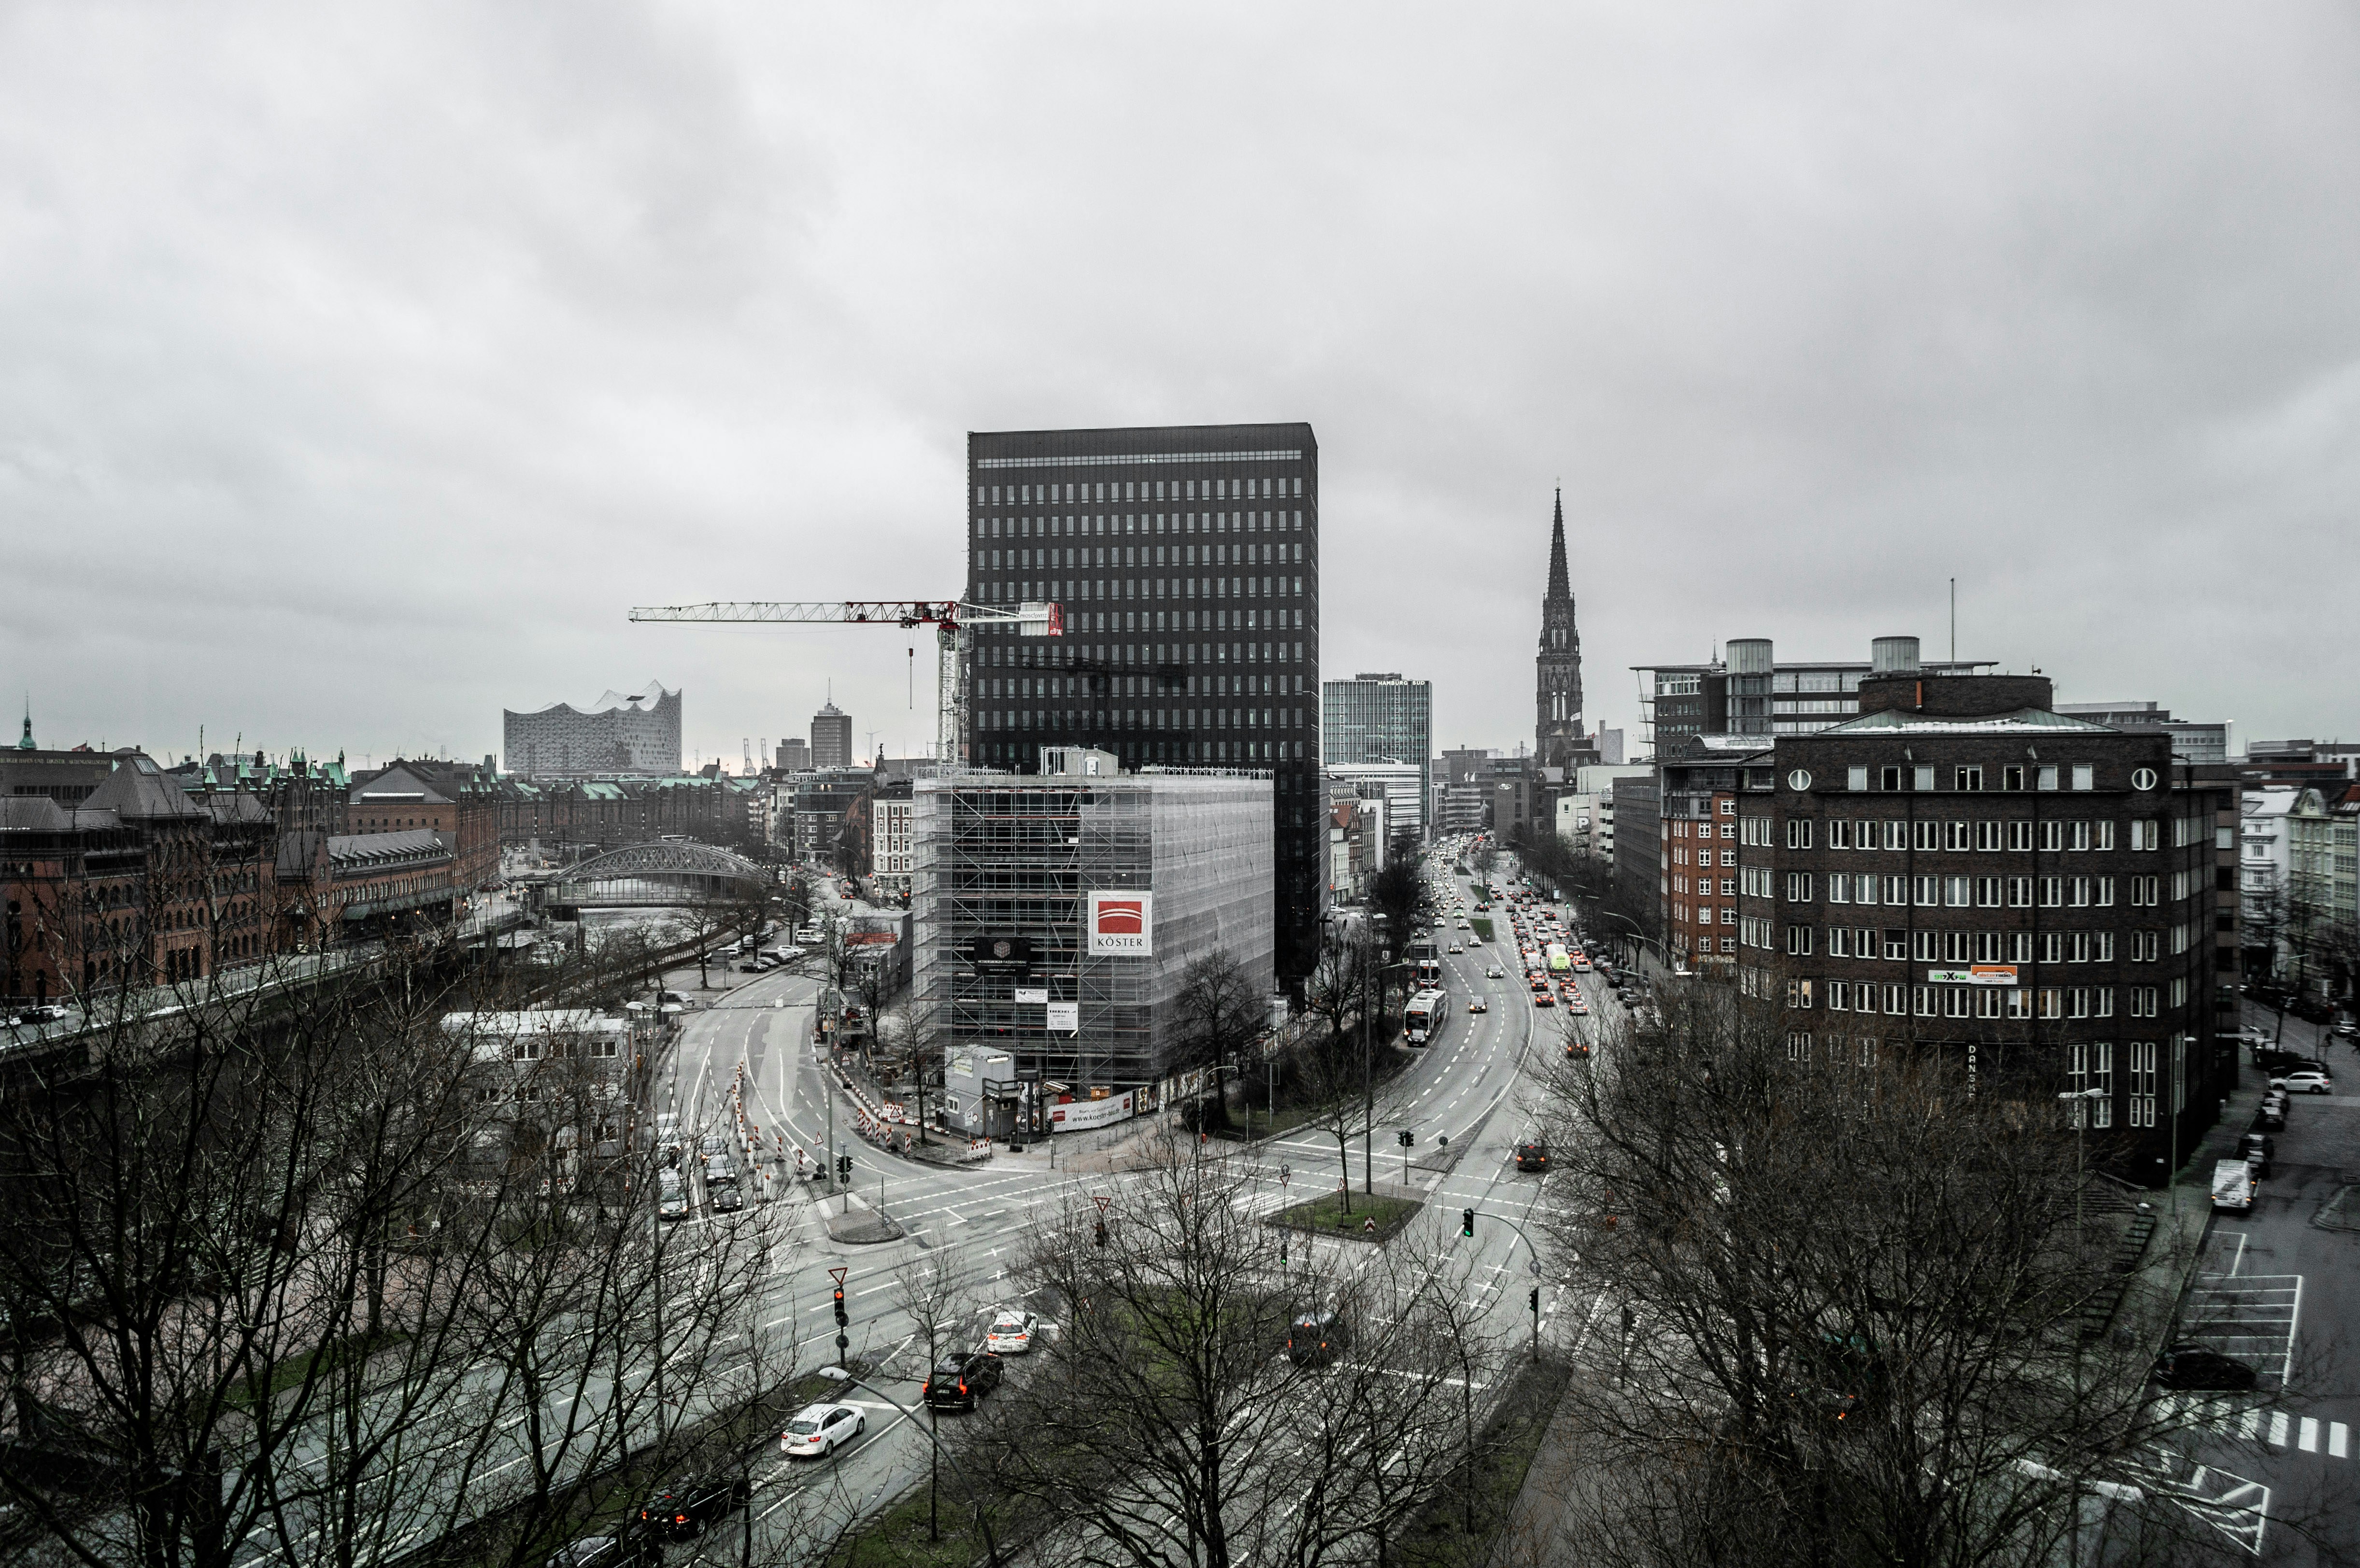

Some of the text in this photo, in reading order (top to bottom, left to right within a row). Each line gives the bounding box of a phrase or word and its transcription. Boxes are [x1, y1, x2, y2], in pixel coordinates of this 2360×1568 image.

[1578, 818, 1589, 828] P
[1098, 936, 1142, 946] KÖSTER
[1072, 1108, 1120, 1122] www.koester-bau.de
